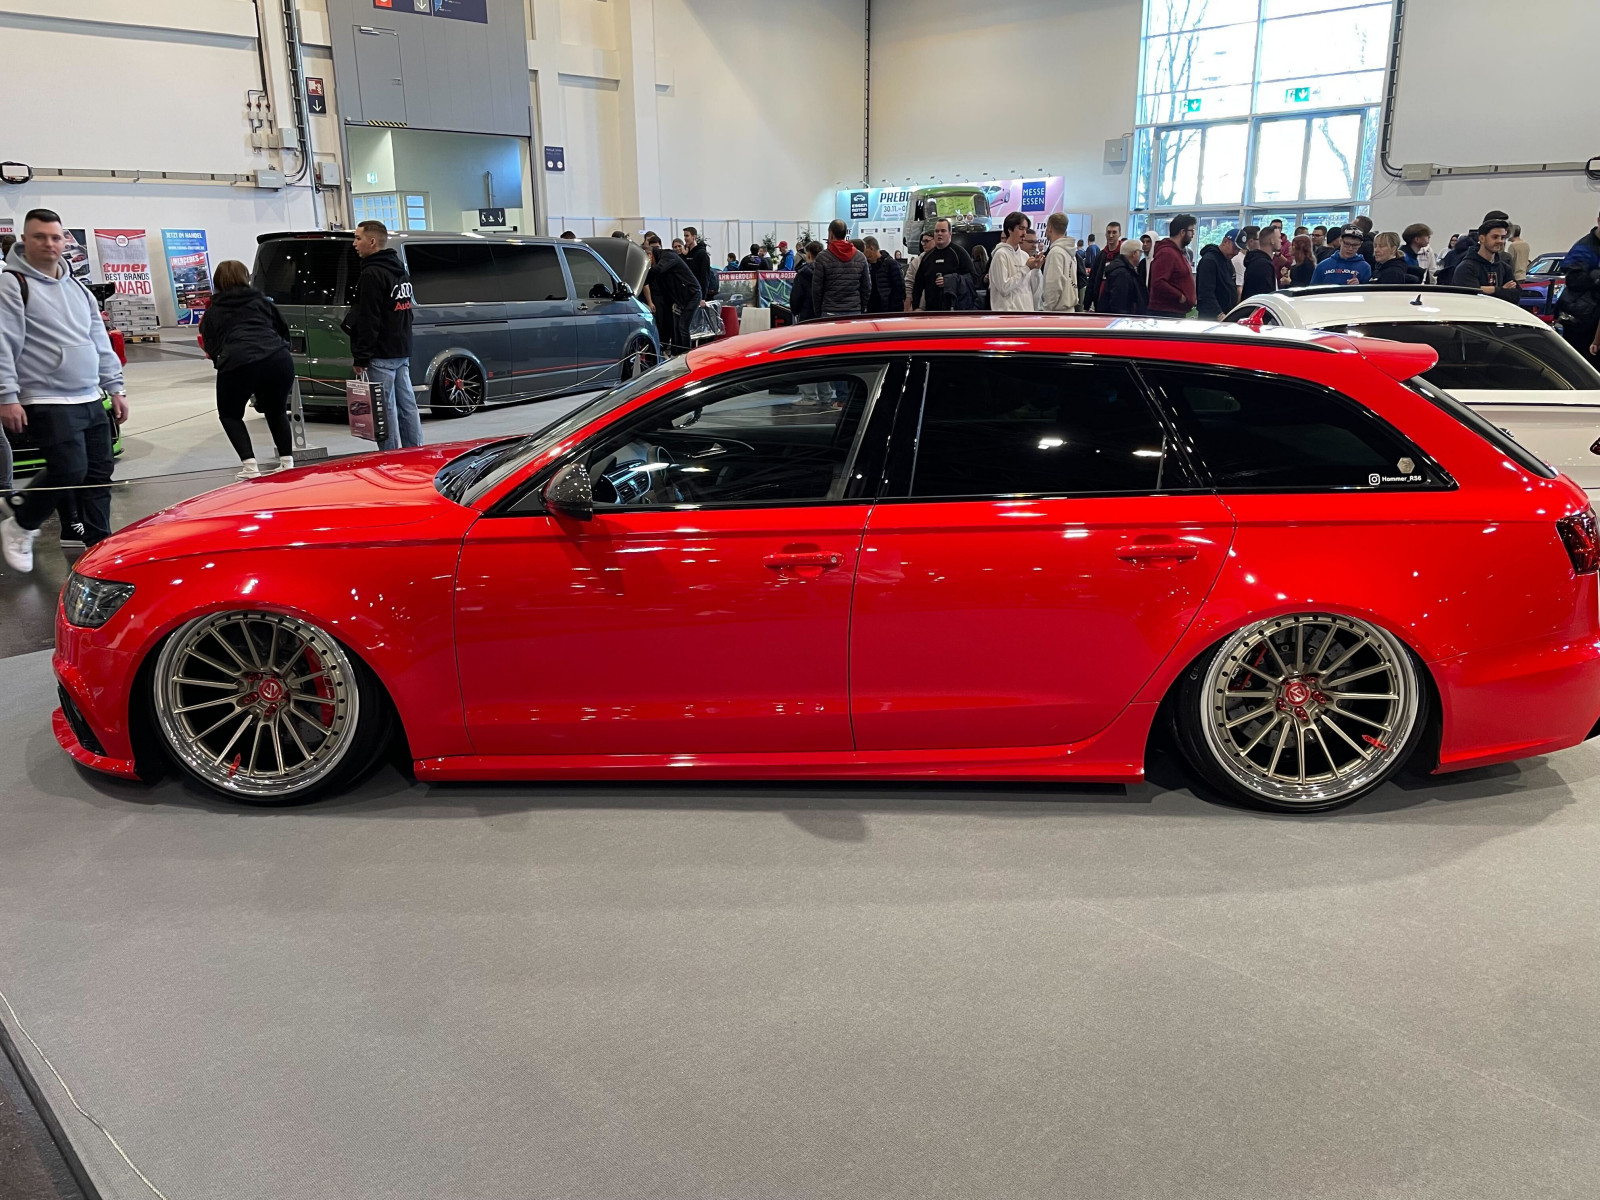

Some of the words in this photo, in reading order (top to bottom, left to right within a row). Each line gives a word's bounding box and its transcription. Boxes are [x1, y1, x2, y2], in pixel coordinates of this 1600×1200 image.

[1022, 187, 1045, 196] MESSE
[1022, 197, 1045, 206] ESSEN
[103, 262, 147, 273] tuner
[105, 273, 121, 281] BEST
[124, 273, 150, 281] BRANDS
[114, 281, 152, 295] WARD
